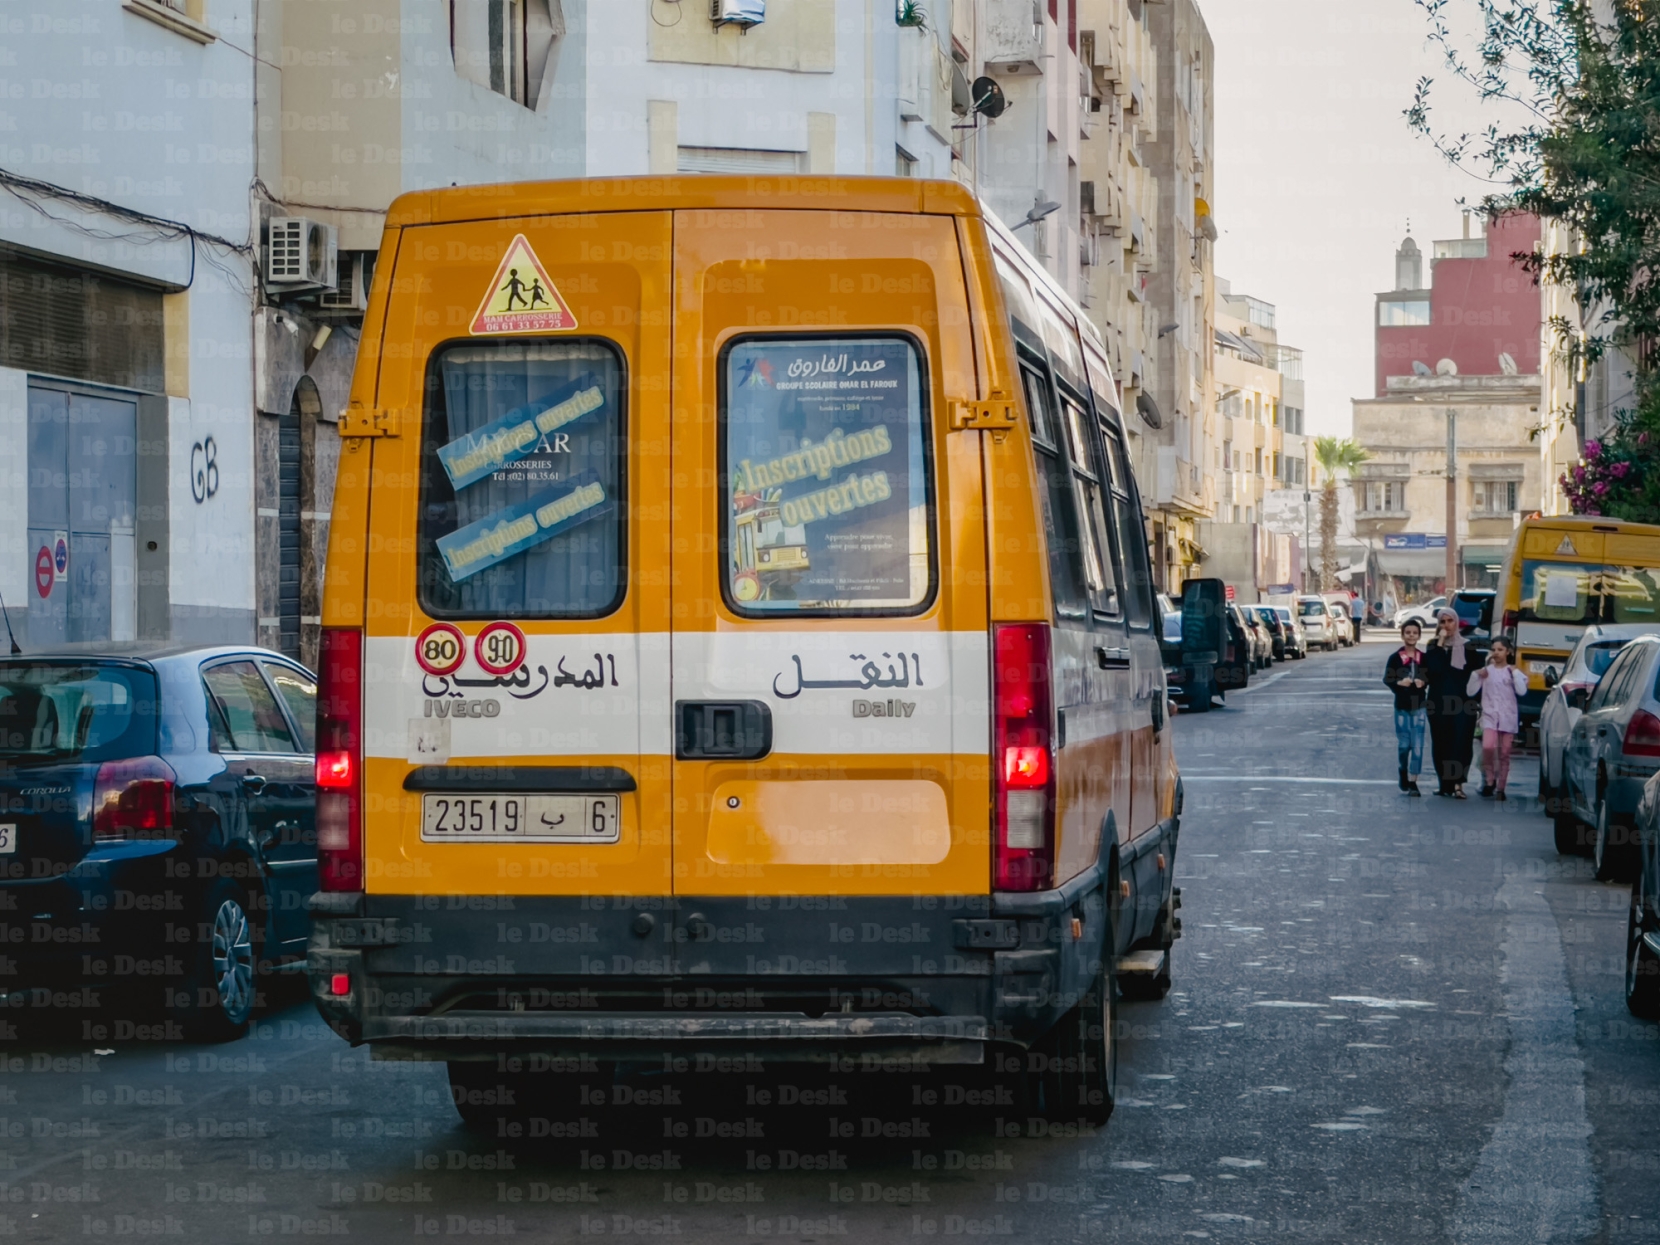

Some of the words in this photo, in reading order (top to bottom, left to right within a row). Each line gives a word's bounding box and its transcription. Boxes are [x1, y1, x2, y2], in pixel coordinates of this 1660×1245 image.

[486, 323, 499, 331] 06
[502, 322, 513, 330] 61
[518, 321, 530, 329] 33
[533, 320, 545, 328] 57
[549, 320, 561, 328] 75
[788, 354, 848, 377] الفاروق
[847, 360, 886, 376] عمر
[776, 381, 803, 390] GROUPE
[805, 381, 838, 390] SCOLAIRE
[861, 380, 869, 388] EL
[870, 380, 898, 388] FAROUK
[537, 386, 603, 433] ouvertes
[741, 424, 891, 491] Inscriptions
[191, 436, 219, 504] GB
[782, 471, 891, 527] ouvertes
[447, 513, 538, 569] Inscriptions
[536, 482, 605, 528] ouvertes
[425, 640, 456, 660] 80
[488, 635, 514, 664] 90
[773, 652, 924, 699] النقل
[424, 699, 500, 718] IVECO
[852, 700, 916, 718] Daily
[20, 786, 72, 795] COROLLA
[436, 800, 518, 832] 23519
[592, 800, 606, 832] 6
[0, 828, 9, 848] 6
